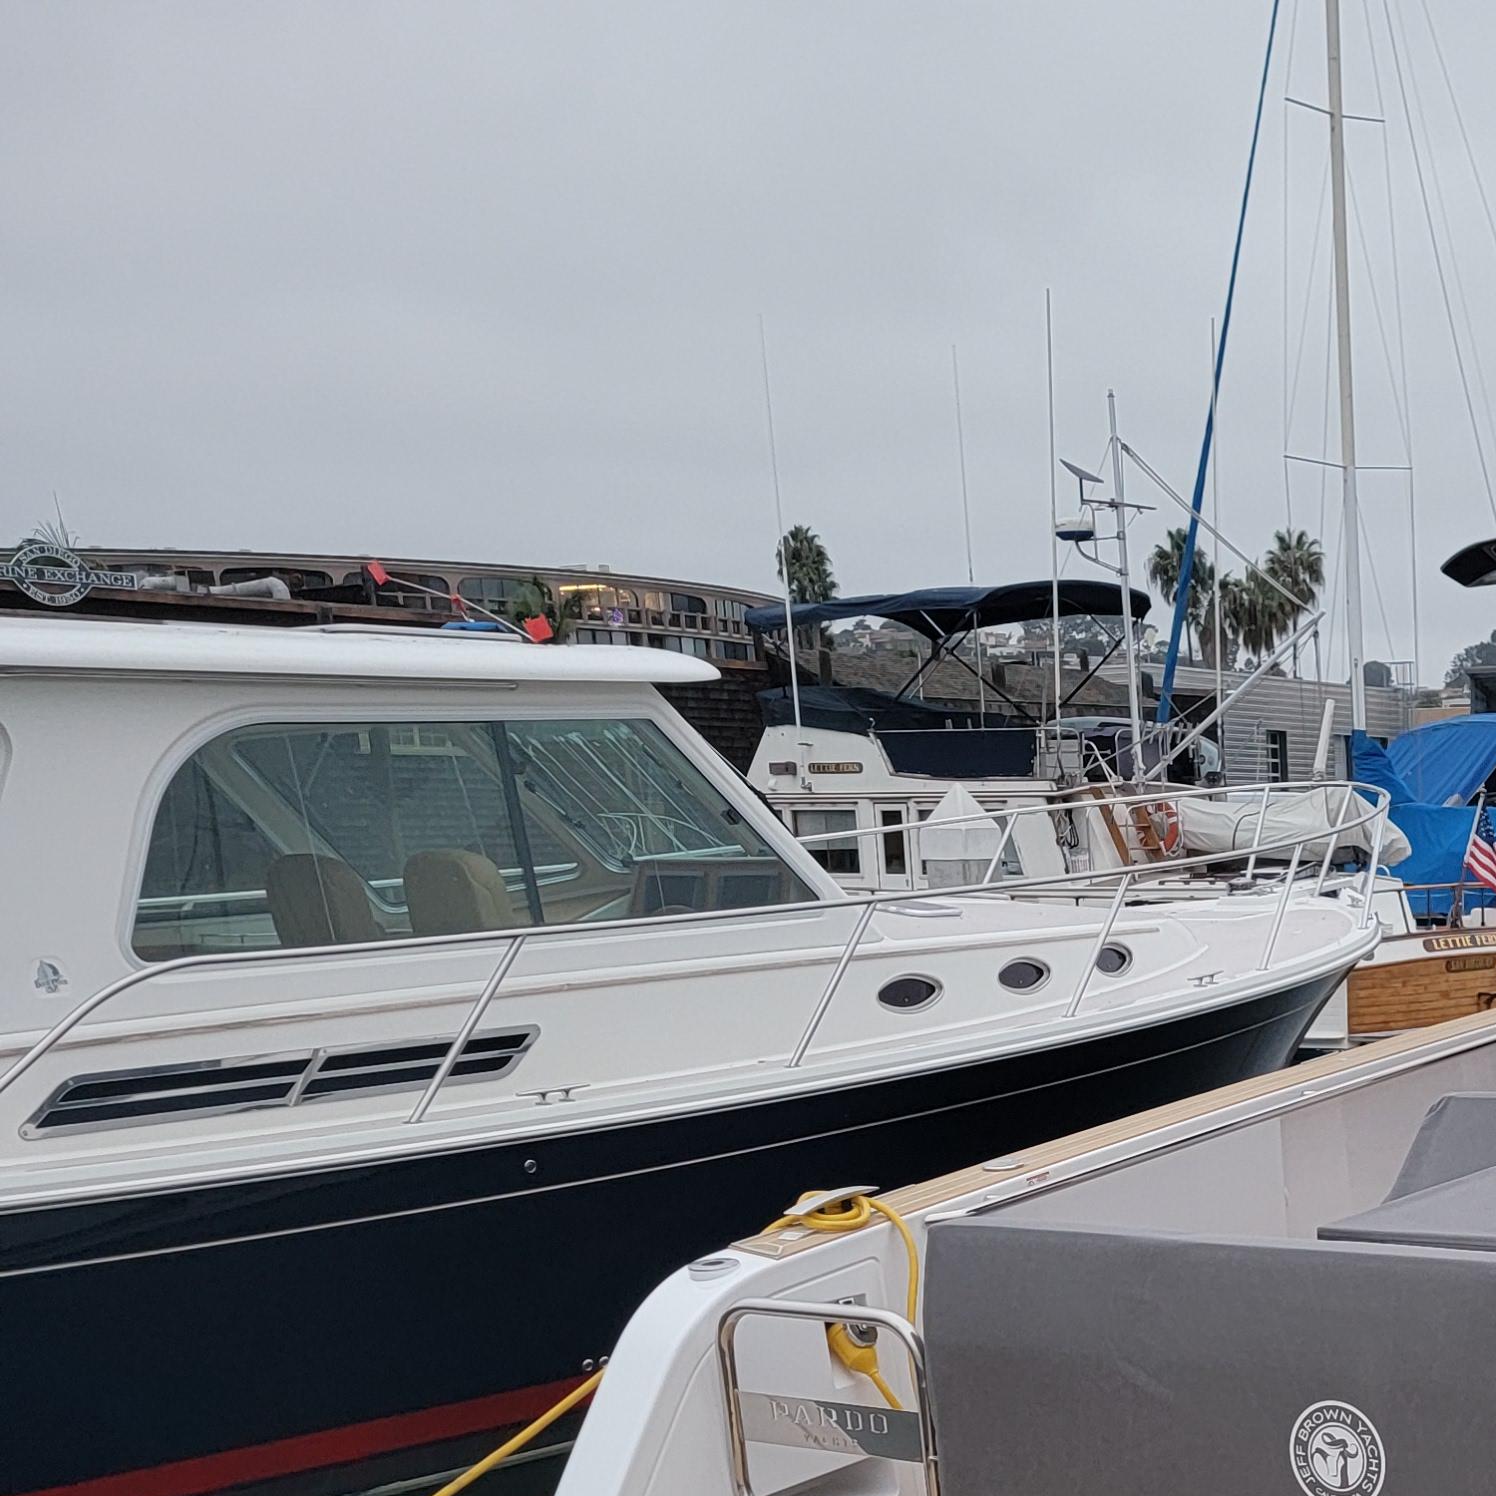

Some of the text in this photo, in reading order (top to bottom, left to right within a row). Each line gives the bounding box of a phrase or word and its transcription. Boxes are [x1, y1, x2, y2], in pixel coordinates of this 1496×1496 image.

[45, 545, 80, 567] DIEGO
[44, 568, 132, 587] EXCHANGE
[1432, 935, 1473, 950] LETTIE
[769, 1400, 889, 1435] PARDO
[1296, 1408, 1380, 1493] JEFF BROWN YACHTS
